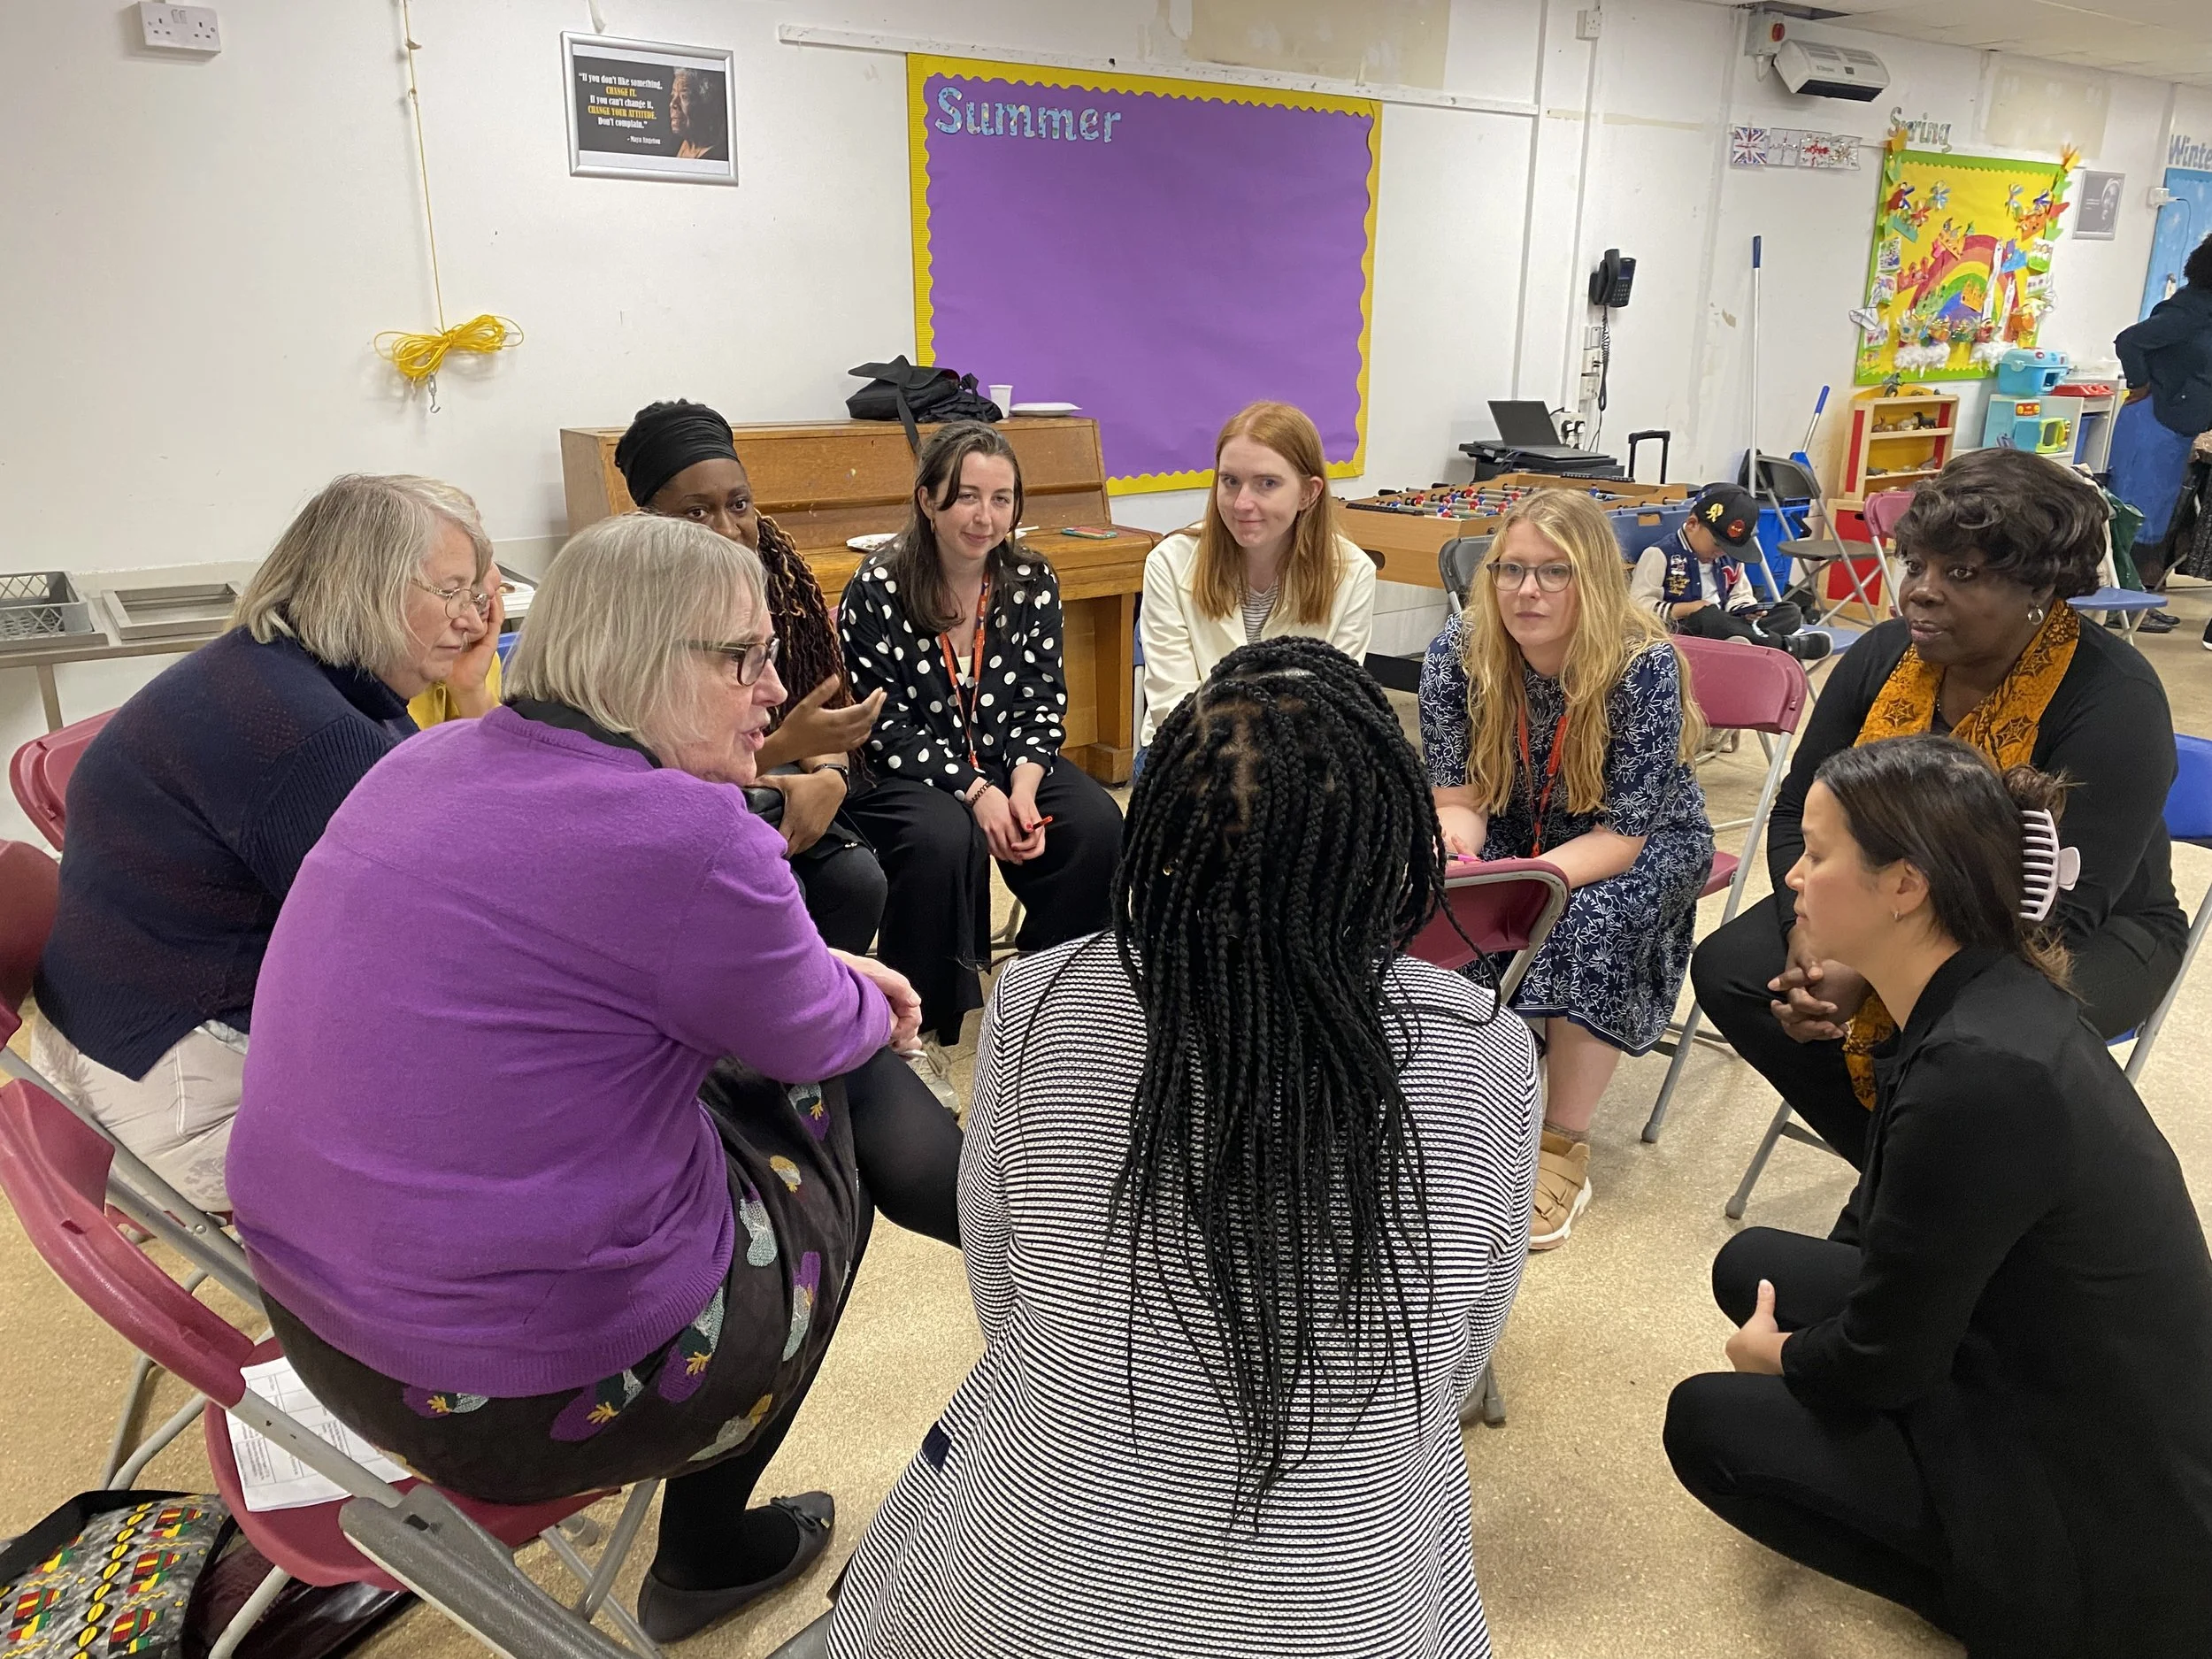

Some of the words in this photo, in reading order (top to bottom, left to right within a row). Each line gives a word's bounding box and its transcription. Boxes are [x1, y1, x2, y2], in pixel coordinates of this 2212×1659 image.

[588, 74, 600, 83] you
[618, 76, 630, 86] like
[605, 86, 628, 96] CHANGE
[596, 96, 608, 105] you
[624, 98, 646, 109] change
[588, 105, 611, 115] CHANGE
[611, 107, 626, 117] YOUR
[934, 87, 1122, 143] Summer
